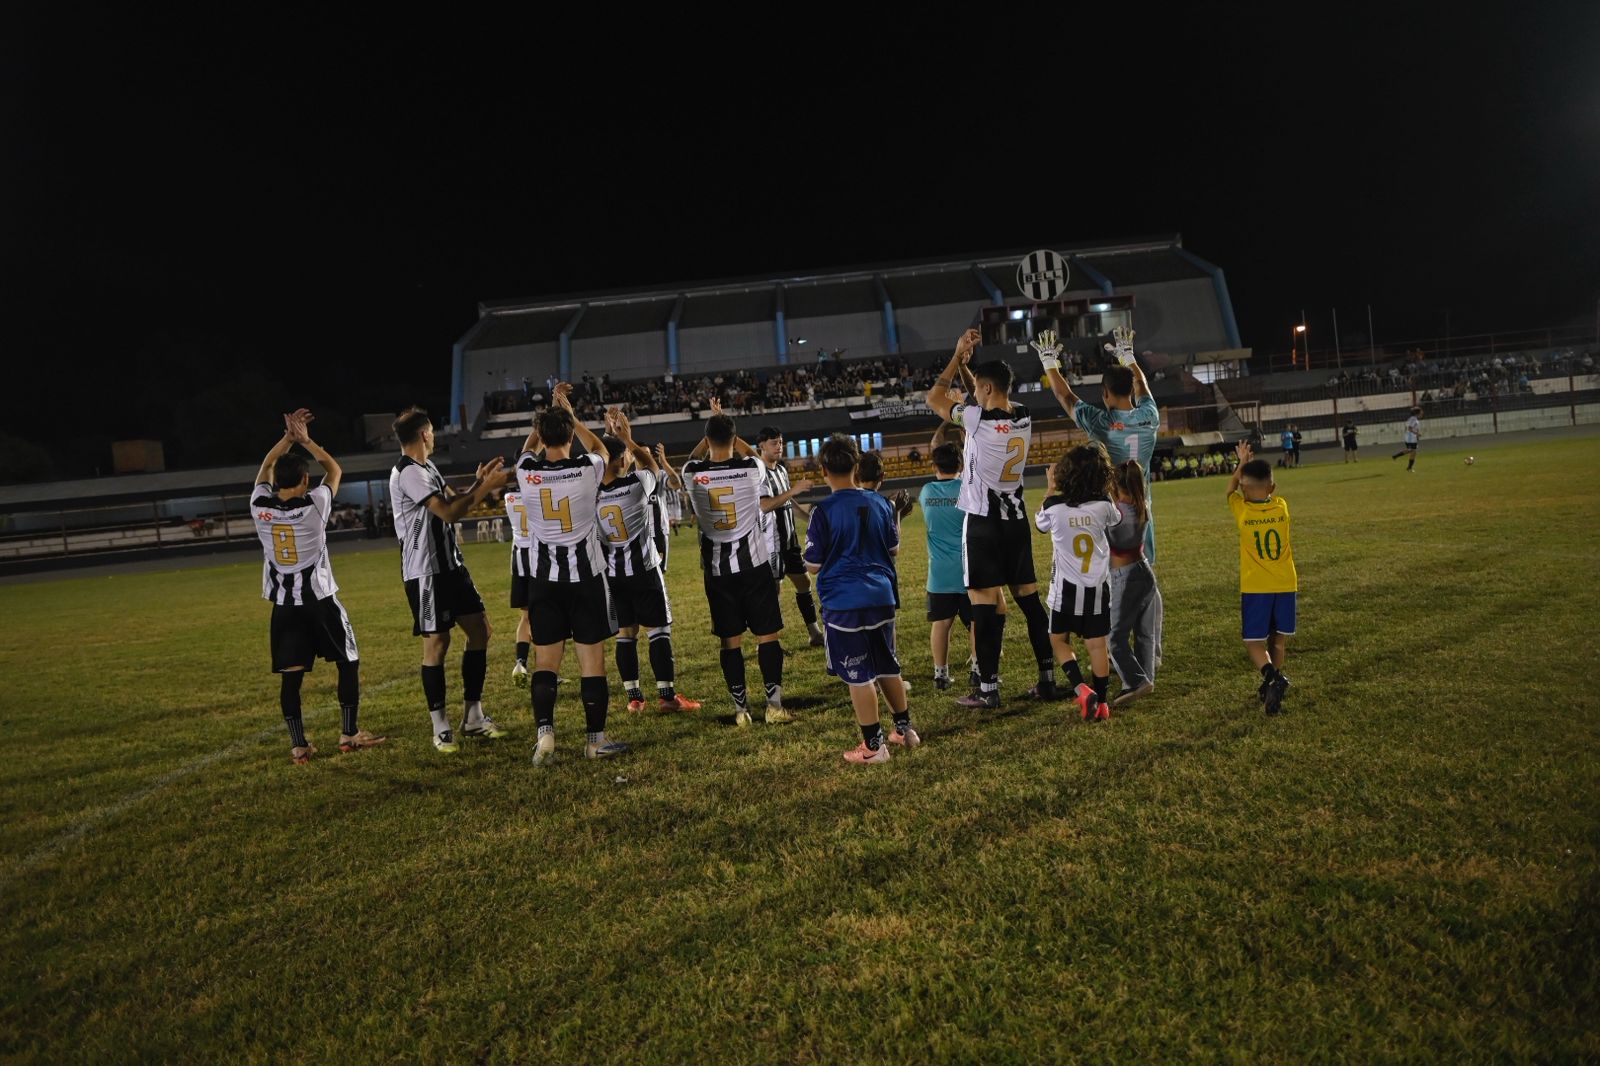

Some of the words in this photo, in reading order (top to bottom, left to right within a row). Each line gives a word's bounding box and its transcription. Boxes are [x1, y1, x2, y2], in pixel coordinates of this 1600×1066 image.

[1025, 270, 1061, 283] BELL
[1000, 437, 1024, 482] 2
[540, 488, 572, 533] 4
[600, 505, 629, 542] 3
[708, 487, 737, 531] 5
[1069, 516, 1091, 527] ELIO
[271, 523, 298, 566] 8
[1073, 533, 1094, 573] 9
[1254, 528, 1281, 560] 10
